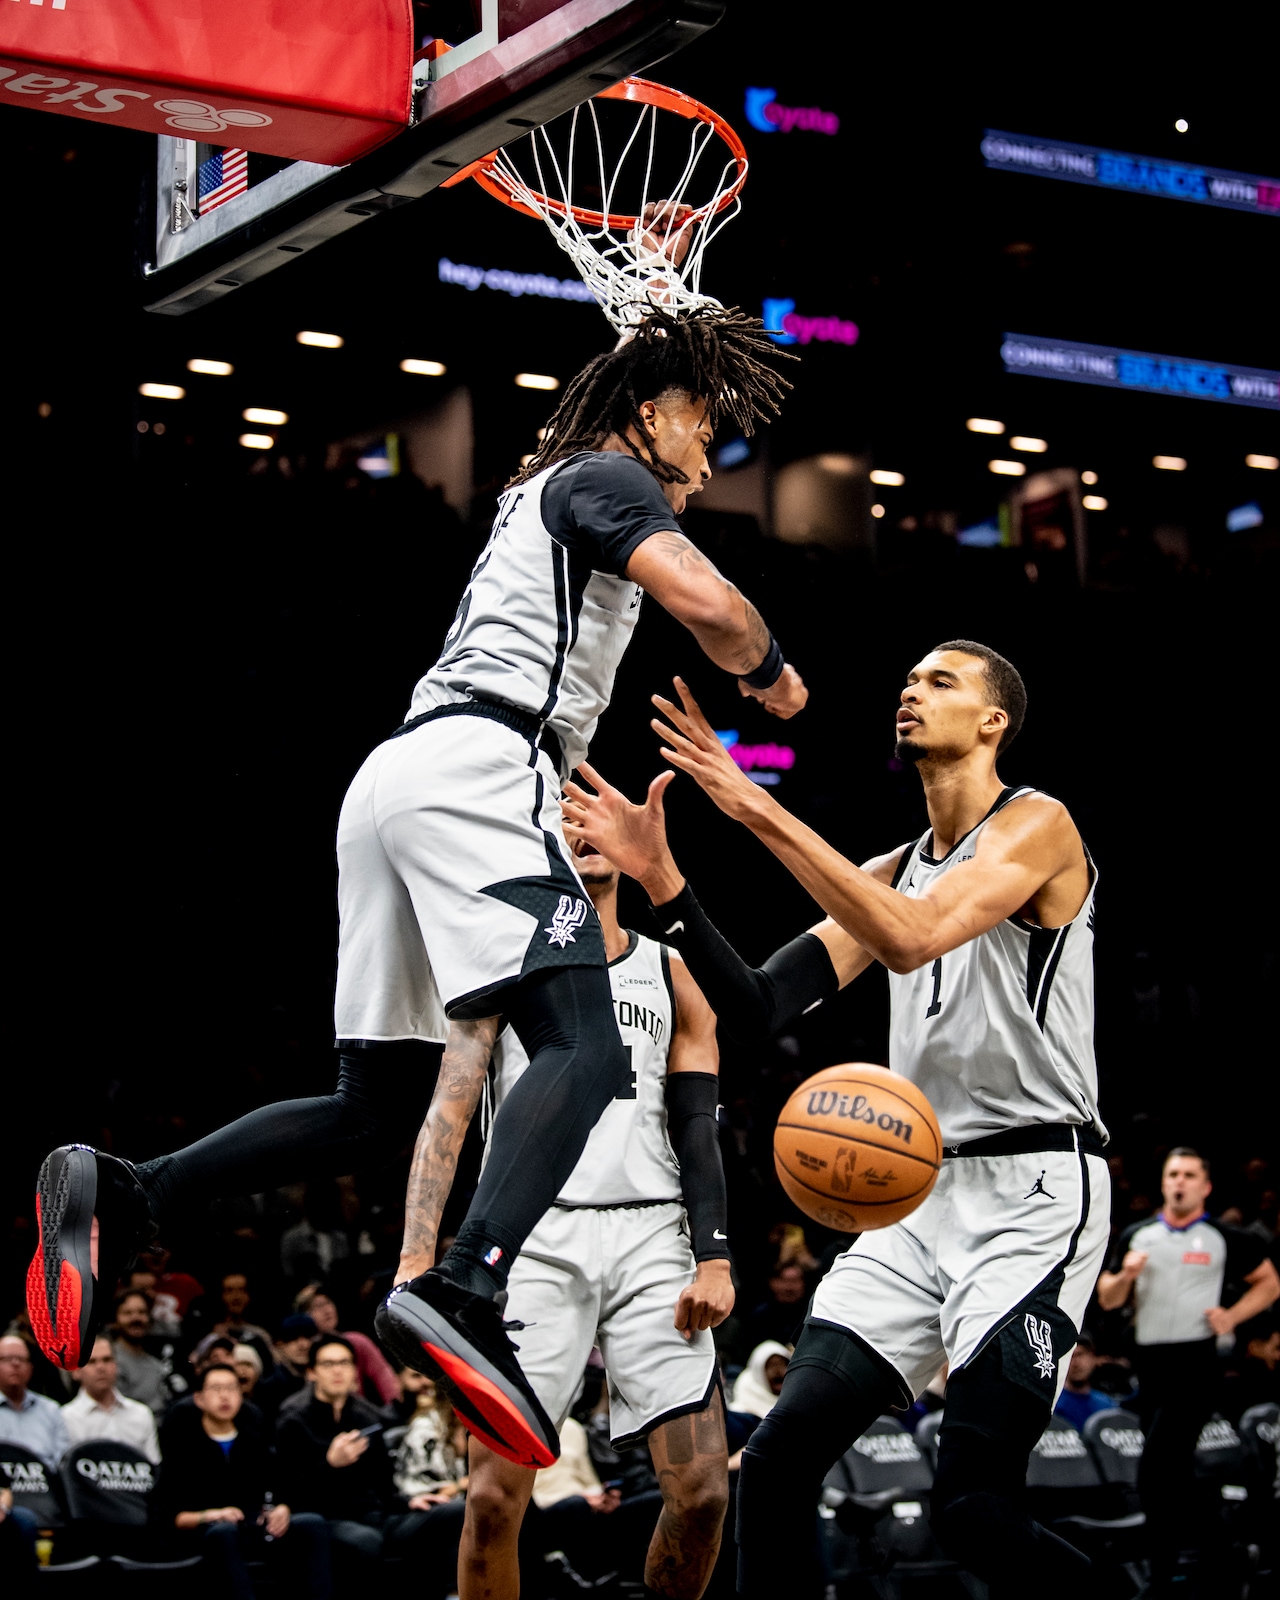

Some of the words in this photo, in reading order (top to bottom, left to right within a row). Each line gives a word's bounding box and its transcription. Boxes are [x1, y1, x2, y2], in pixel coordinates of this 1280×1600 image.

[0, 67, 151, 113] Sta
[807, 1091, 913, 1145] Wilson
[76, 1457, 153, 1482] QATAR
